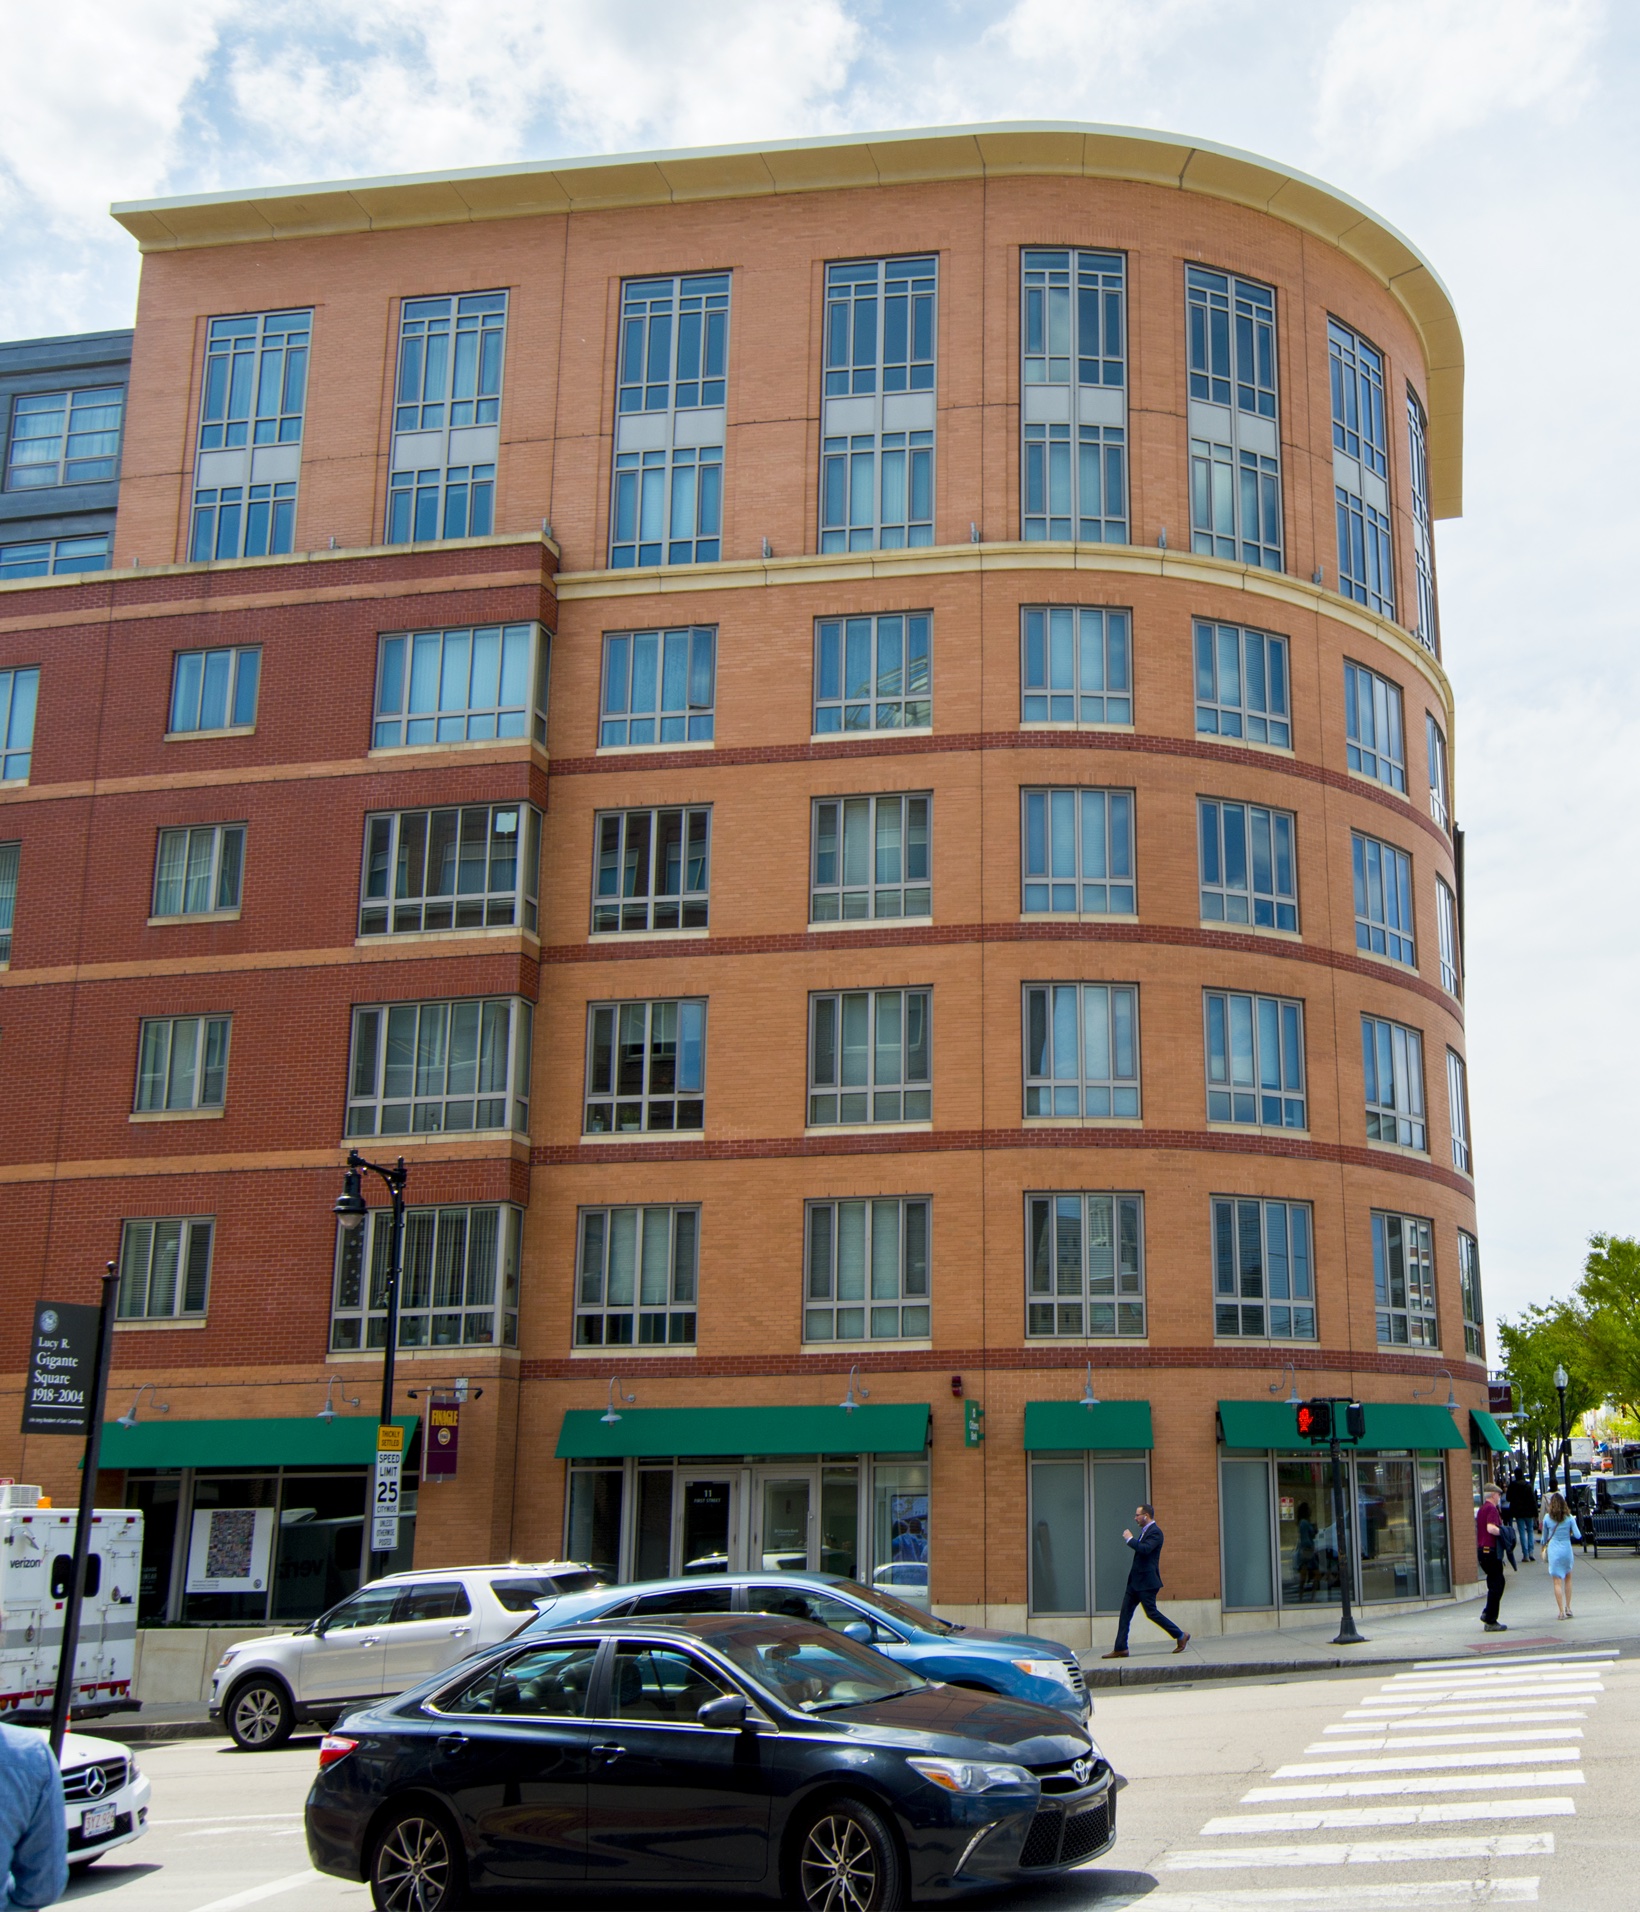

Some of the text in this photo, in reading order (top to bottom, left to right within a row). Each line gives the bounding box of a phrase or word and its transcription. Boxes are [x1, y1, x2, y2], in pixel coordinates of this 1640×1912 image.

[38, 1336, 70, 1350] Lucy R.
[36, 1351, 79, 1369] Gigante
[34, 1369, 70, 1387] Square
[31, 1388, 83, 1403] 1918-2004
[431, 1409, 459, 1426] FINAGLE
[379, 1454, 400, 1464] SPEED
[380, 1466, 398, 1476] LIMIT
[377, 1482, 398, 1502] 25
[10, 1556, 41, 1568] verizon
